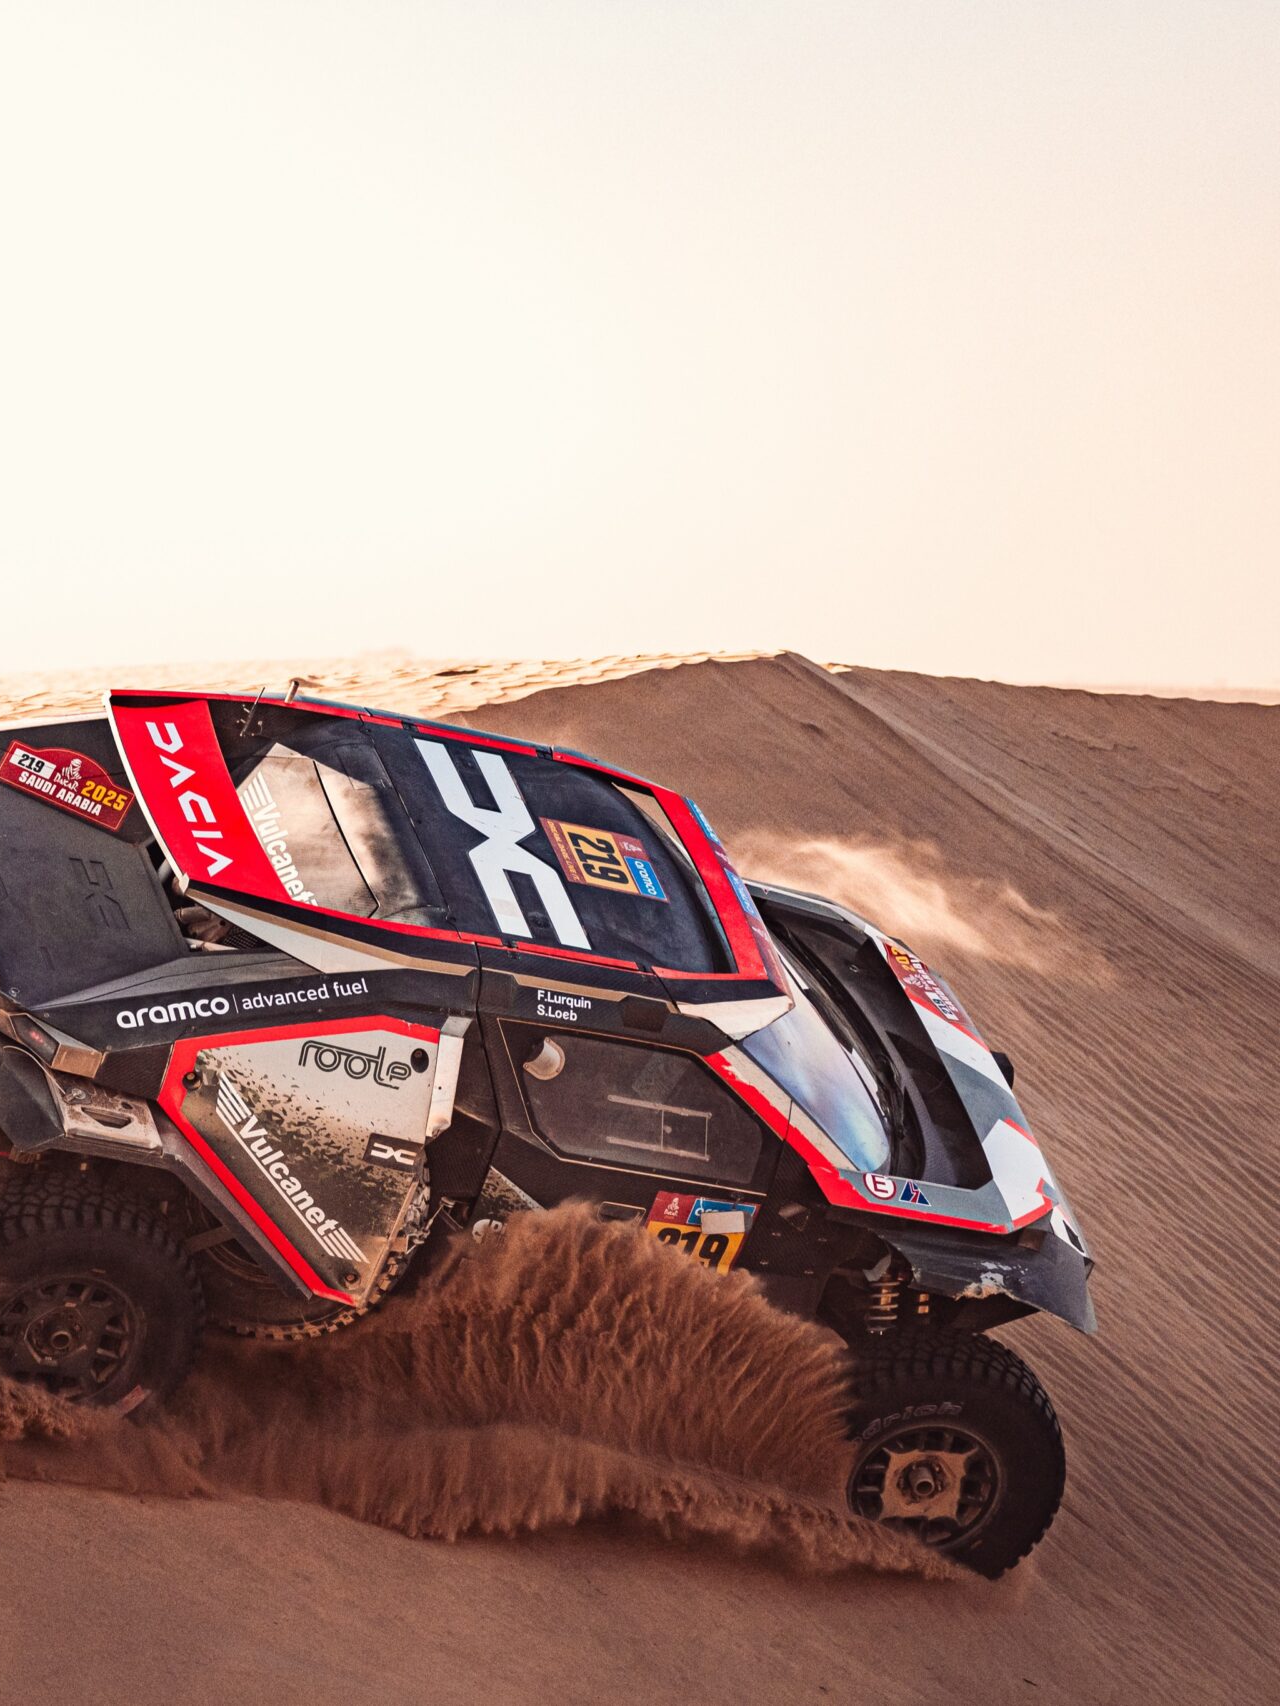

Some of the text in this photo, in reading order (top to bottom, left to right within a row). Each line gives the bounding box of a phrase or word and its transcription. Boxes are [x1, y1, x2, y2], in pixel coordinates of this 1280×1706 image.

[17, 753, 45, 773] 219
[18, 771, 102, 816] SAUDI ARABIA
[80, 780, 128, 812] 2025
[145, 721, 233, 877] DACIA
[568, 832, 629, 884] 219
[635, 860, 657, 896] aramco
[116, 978, 369, 1029] aramco advanced fuel
[537, 990, 592, 1009] F.Lurquin
[537, 1004, 578, 1021] S.Loeb
[239, 1115, 340, 1236] Vulcanet
[871, 1174, 889, 1194] E
